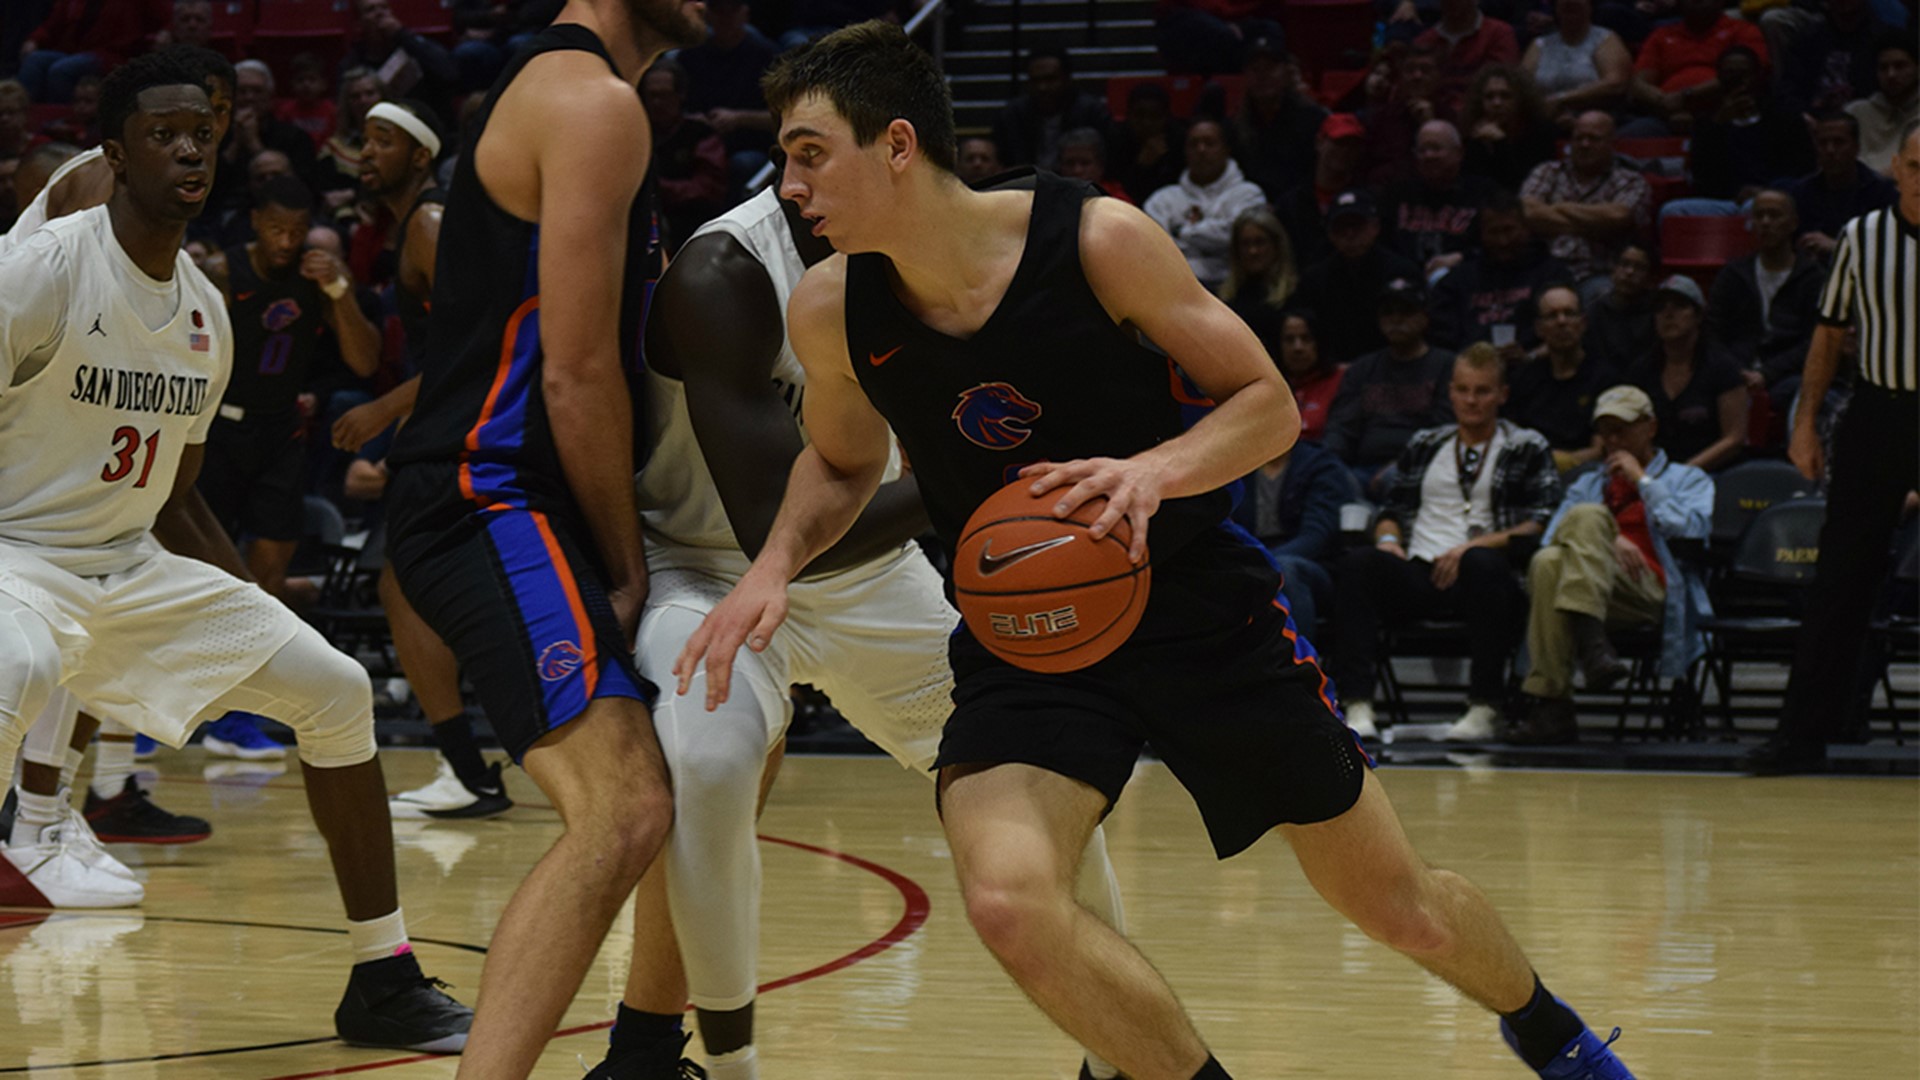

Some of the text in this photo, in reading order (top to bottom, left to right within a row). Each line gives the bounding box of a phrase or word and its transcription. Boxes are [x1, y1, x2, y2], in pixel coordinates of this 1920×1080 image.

[70, 364, 113, 407] SAN
[115, 369, 165, 413] DIEGO
[101, 425, 161, 488] 31
[988, 605, 1079, 636] ELITE
